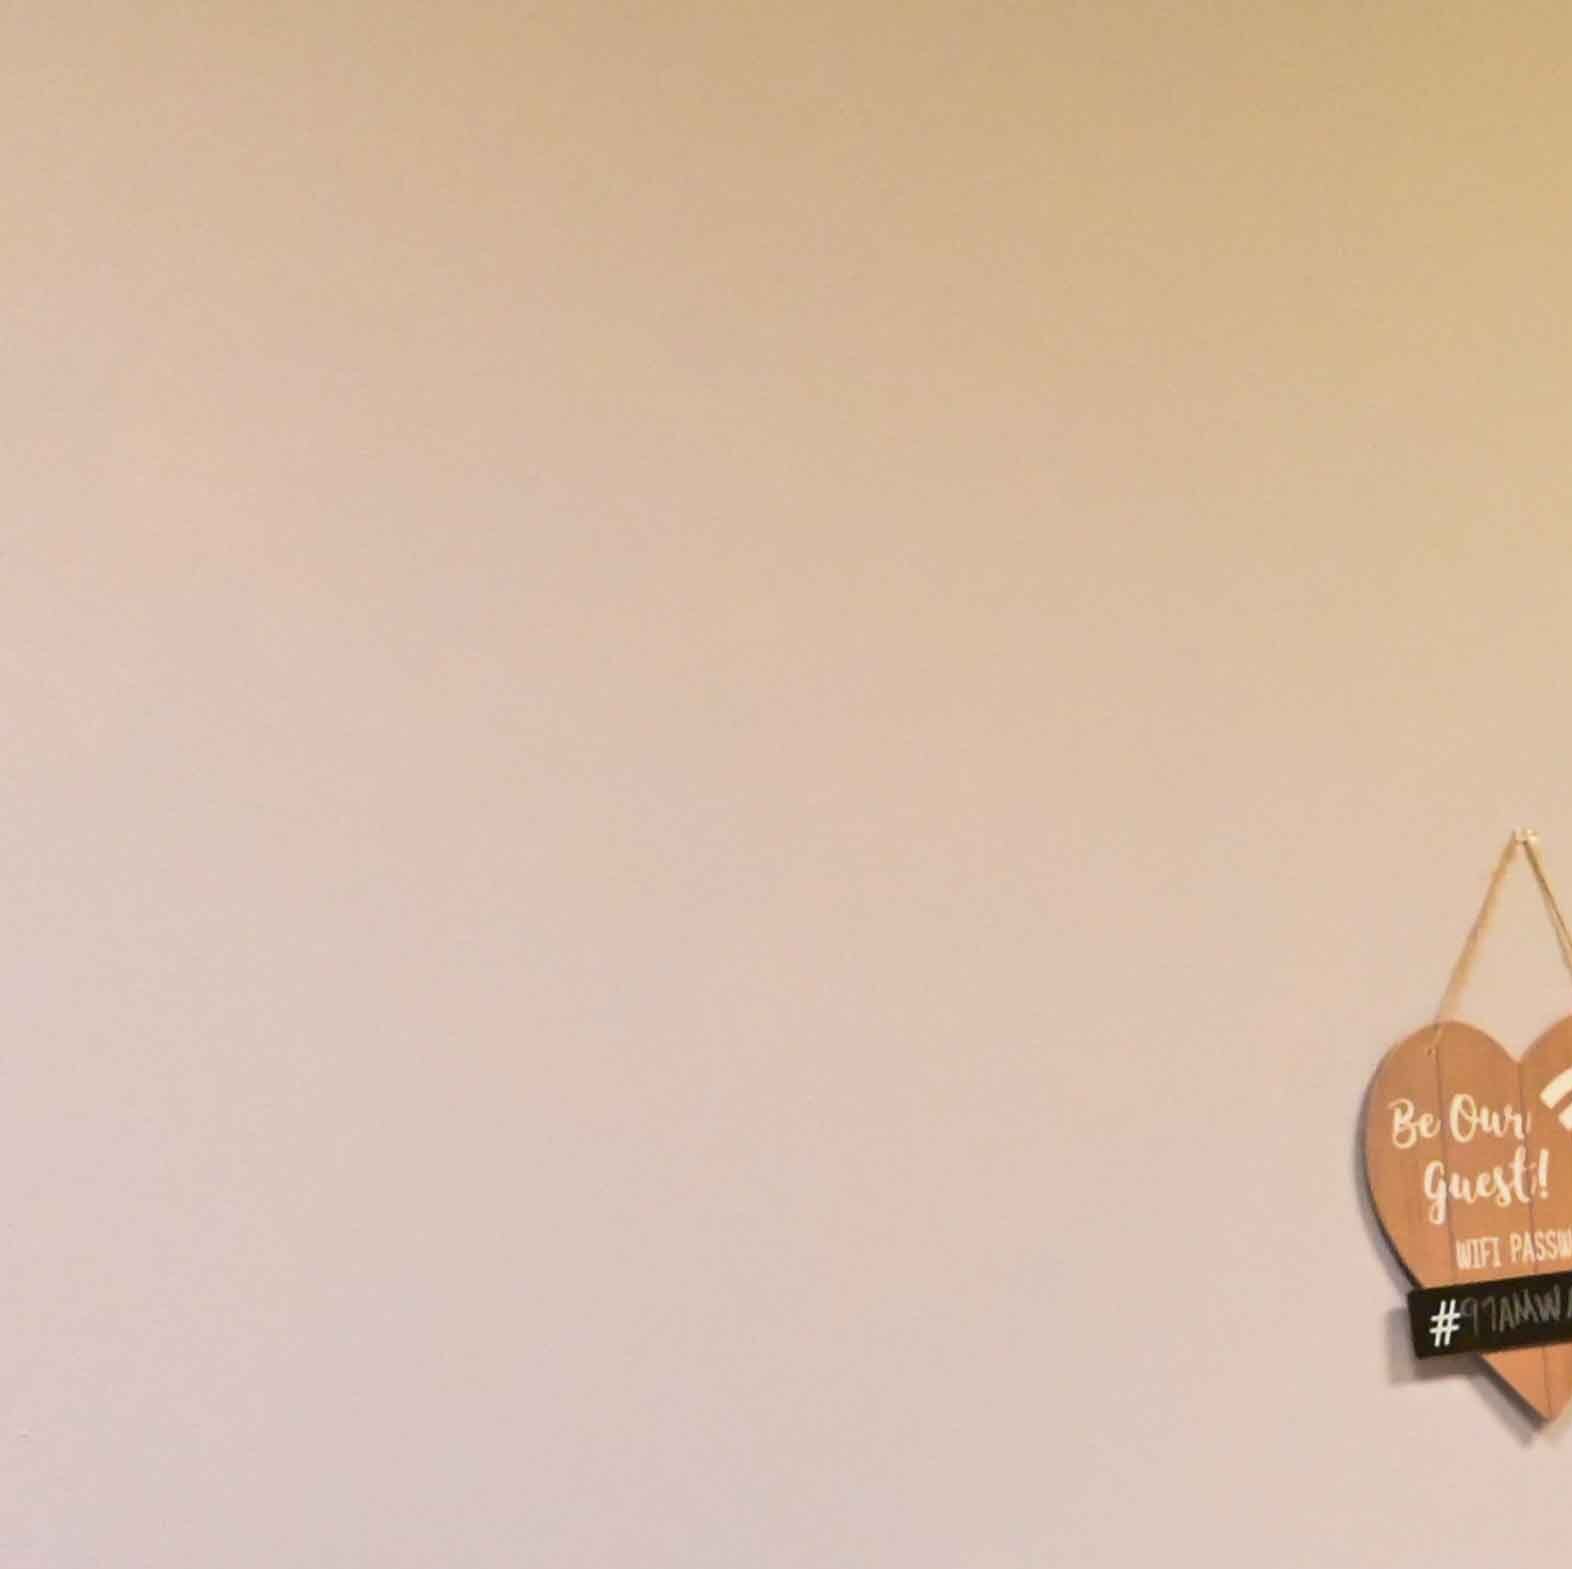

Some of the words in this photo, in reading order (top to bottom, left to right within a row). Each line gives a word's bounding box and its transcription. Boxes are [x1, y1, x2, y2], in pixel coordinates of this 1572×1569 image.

[1387, 1098, 1441, 1149] Be
[1450, 1093, 1532, 1142] Our
[1456, 1237, 1501, 1269] WIFI
